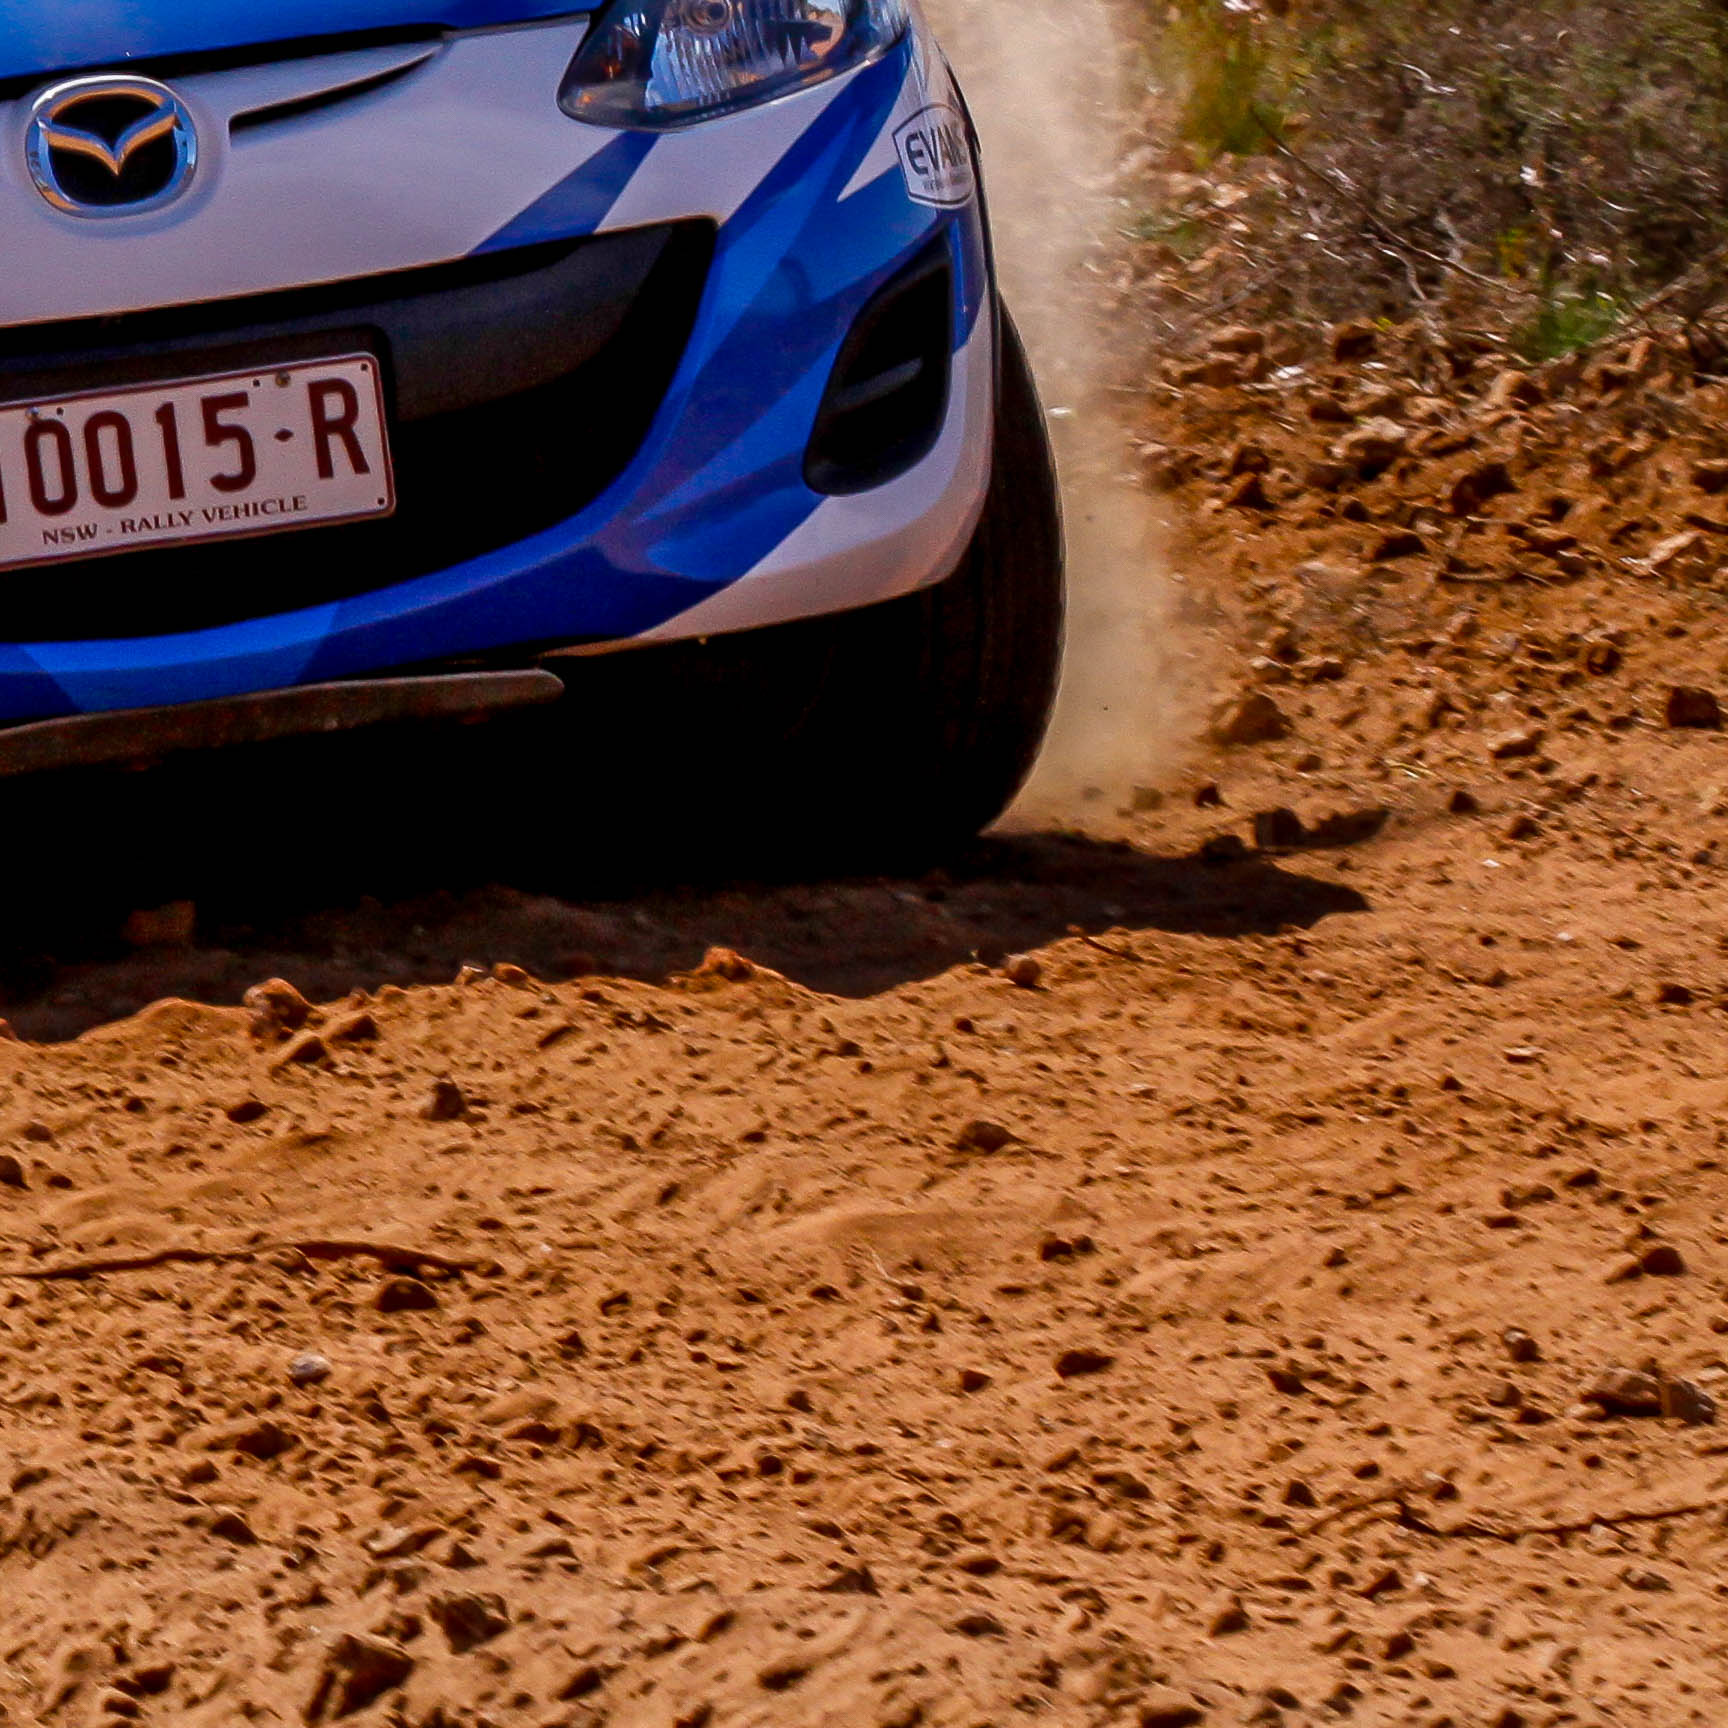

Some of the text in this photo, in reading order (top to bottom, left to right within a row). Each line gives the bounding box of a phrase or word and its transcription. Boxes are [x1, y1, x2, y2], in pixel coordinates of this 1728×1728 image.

[42, 523, 97, 546] NSW
[120, 510, 192, 535] RALLY
[201, 495, 308, 525] VEHICLE
